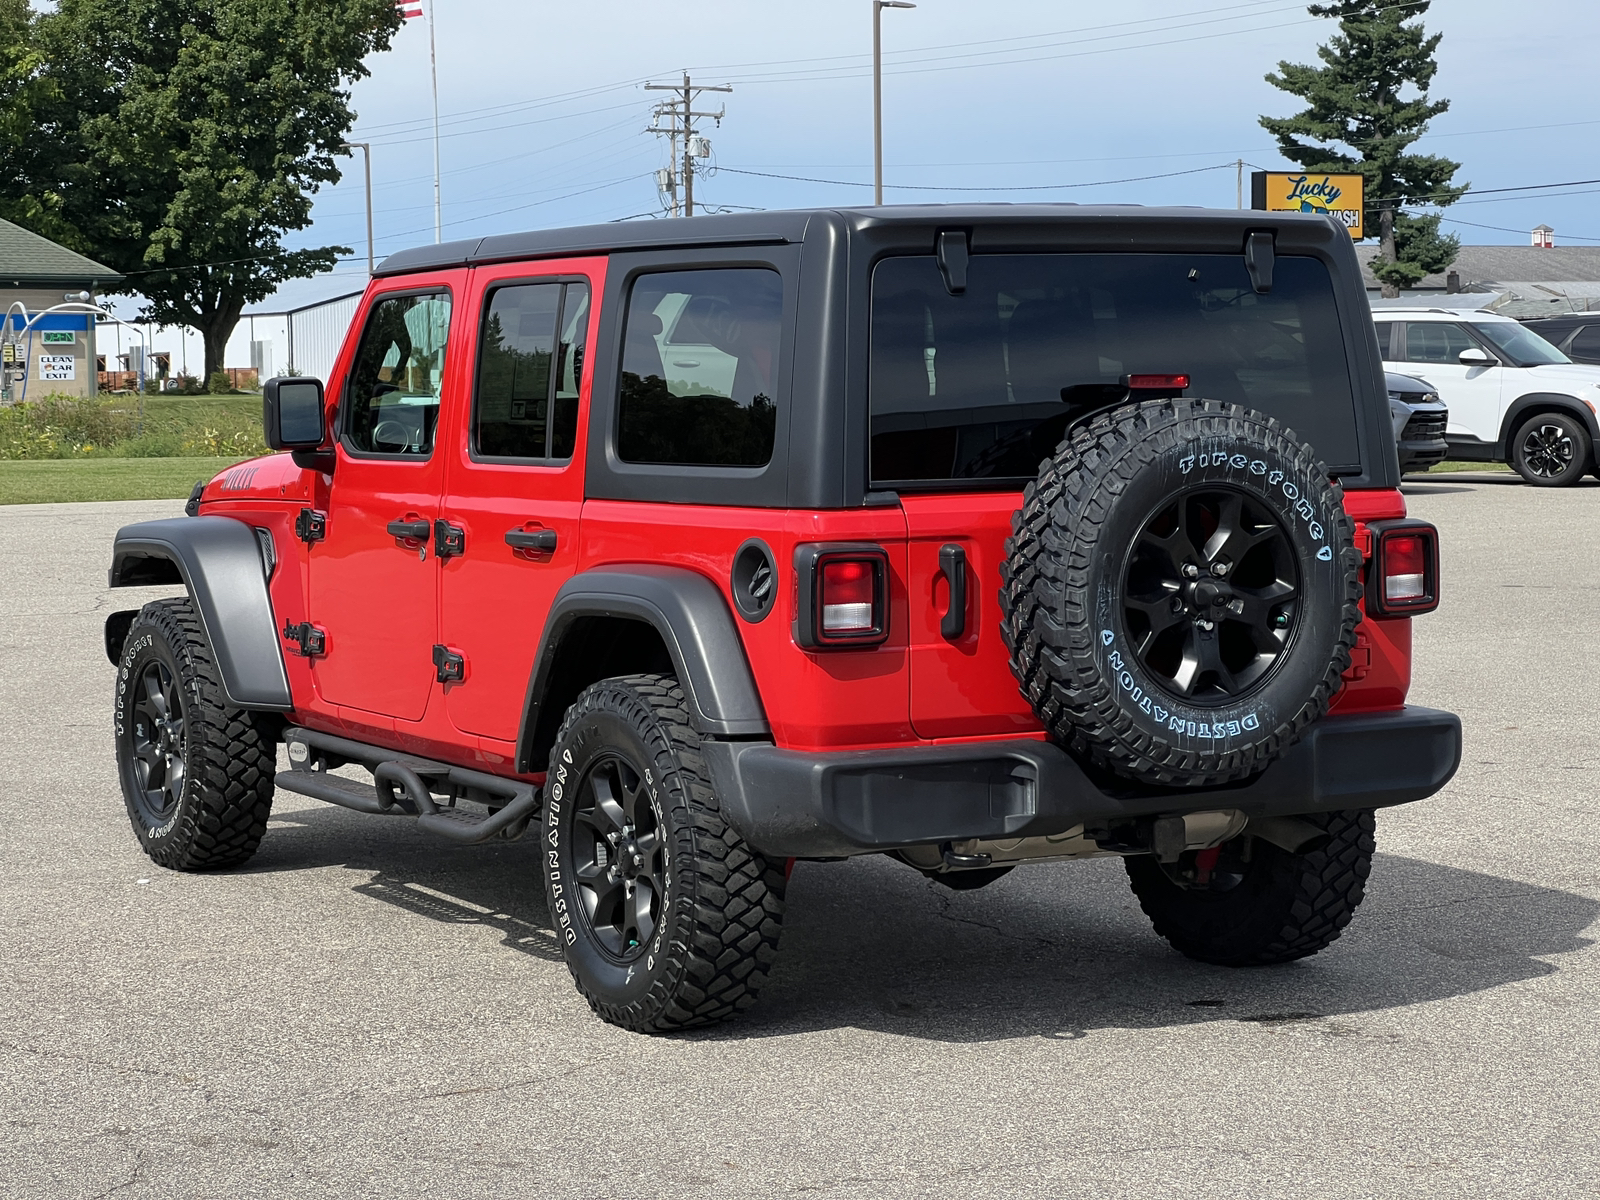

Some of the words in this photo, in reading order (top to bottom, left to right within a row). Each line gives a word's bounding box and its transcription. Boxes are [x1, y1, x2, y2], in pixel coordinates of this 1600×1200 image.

[1286, 176, 1341, 204] Lucky
[43, 332, 75, 342] OPEN
[1180, 452, 1324, 541] Firestone
[1109, 650, 1260, 739] DESTINATION
[548, 766, 577, 947] DESTINATION
